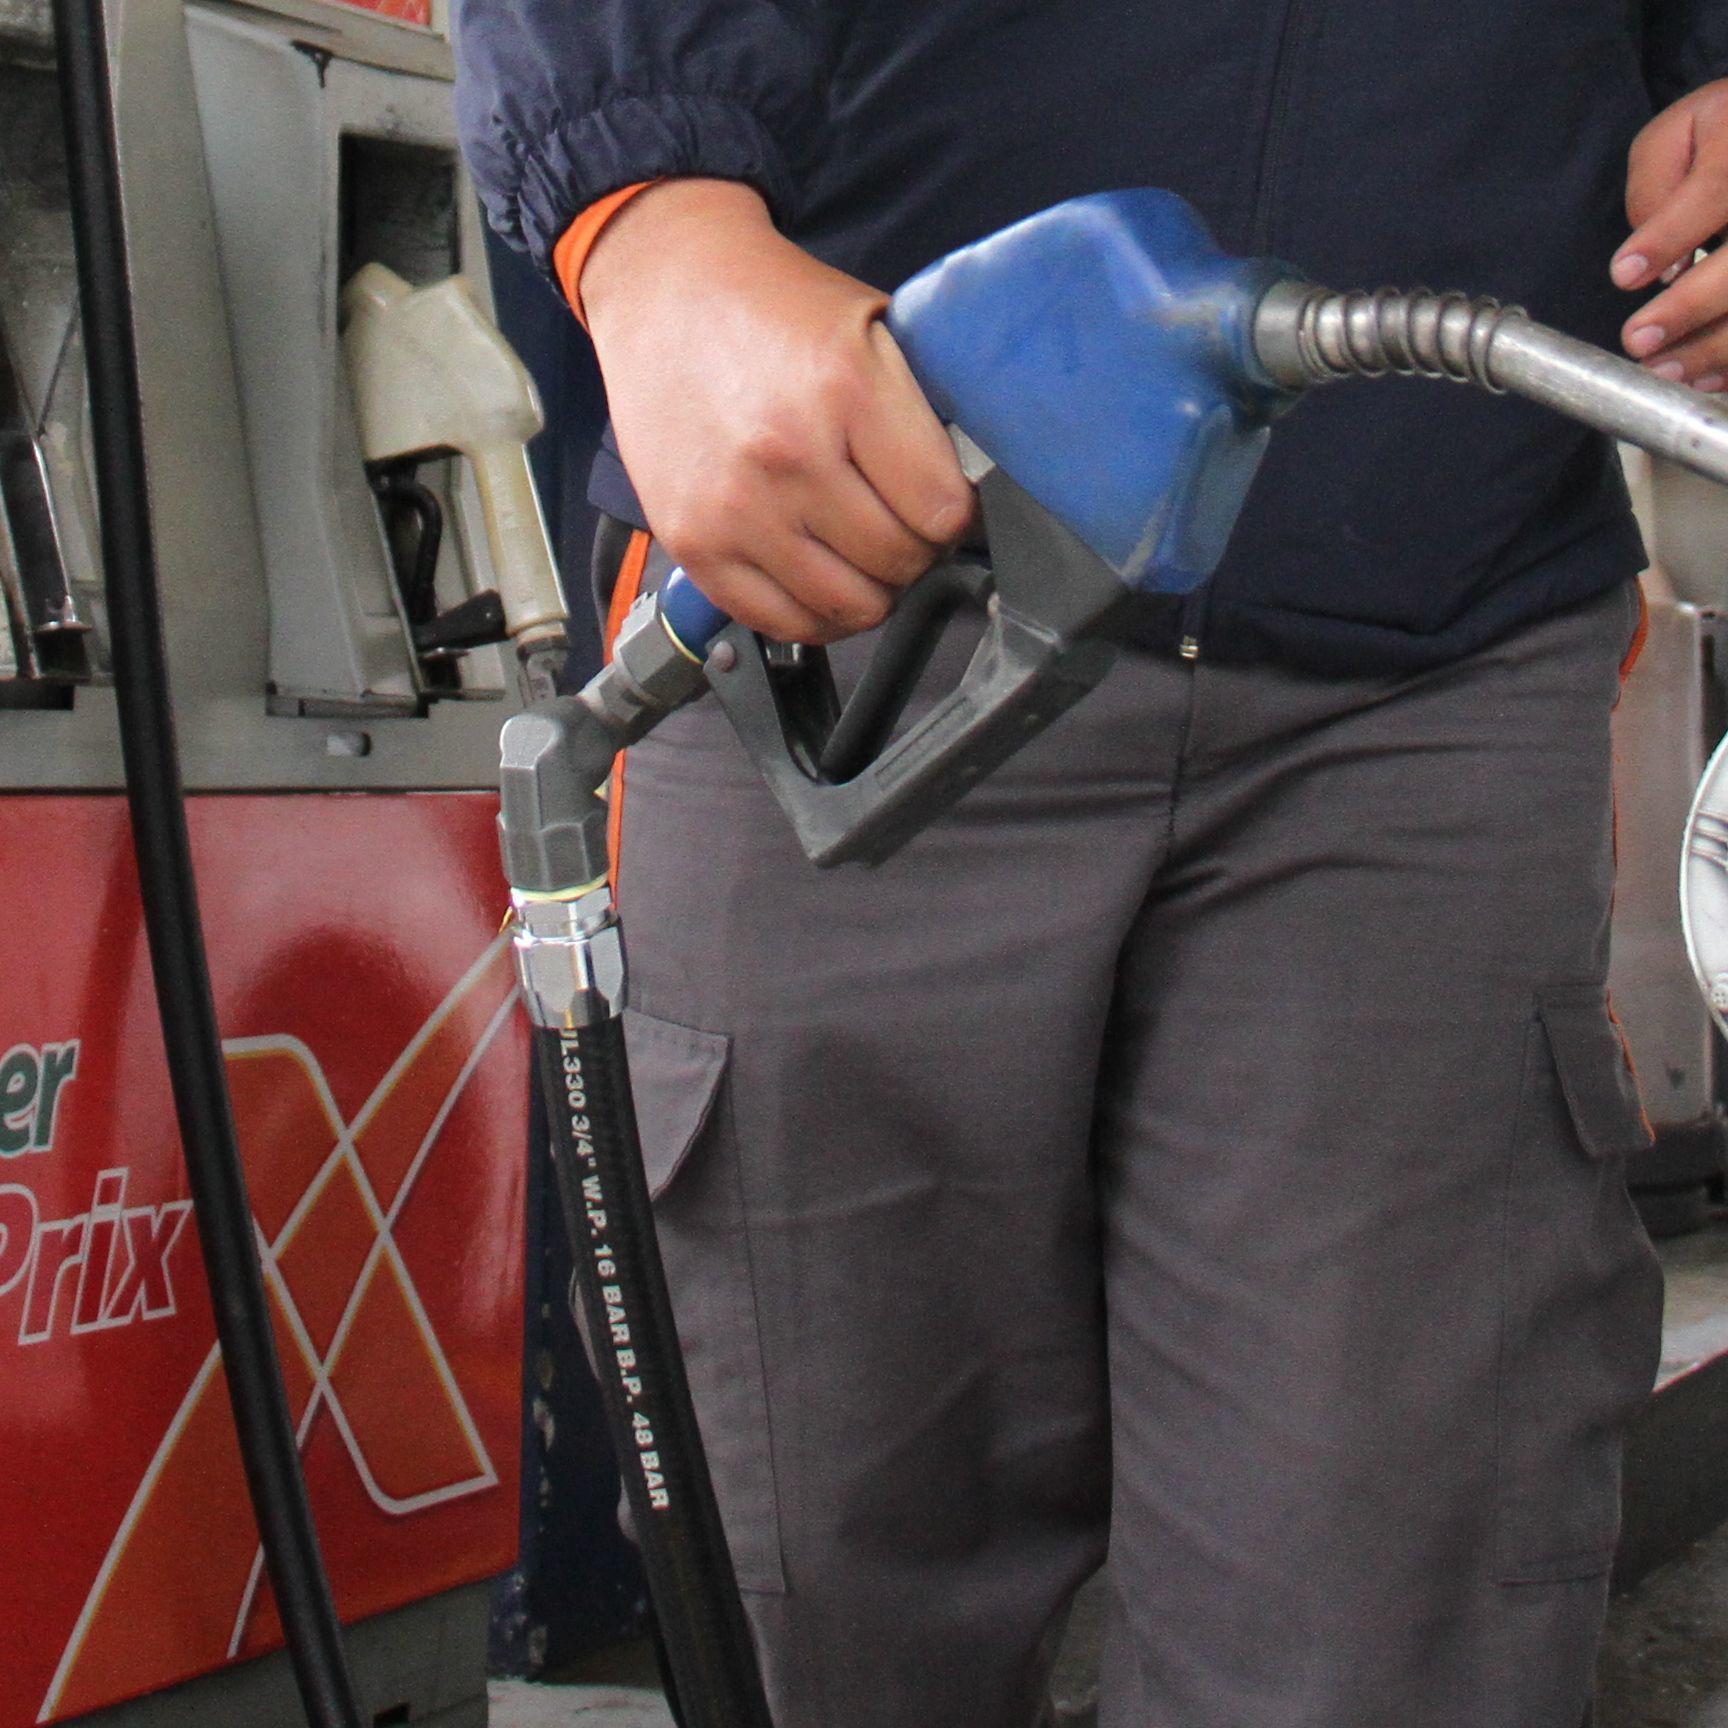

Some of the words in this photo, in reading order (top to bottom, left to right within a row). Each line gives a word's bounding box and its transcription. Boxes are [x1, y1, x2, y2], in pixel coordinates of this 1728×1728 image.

[572, 1114, 597, 1168] 3/4"
[582, 1174, 607, 1237] W.P.
[594, 1243, 616, 1278] 16
[602, 1284, 631, 1346] BAR
[616, 1348, 643, 1404] B.P.
[632, 1411, 654, 1447] 48
[640, 1450, 670, 1510] BAR
